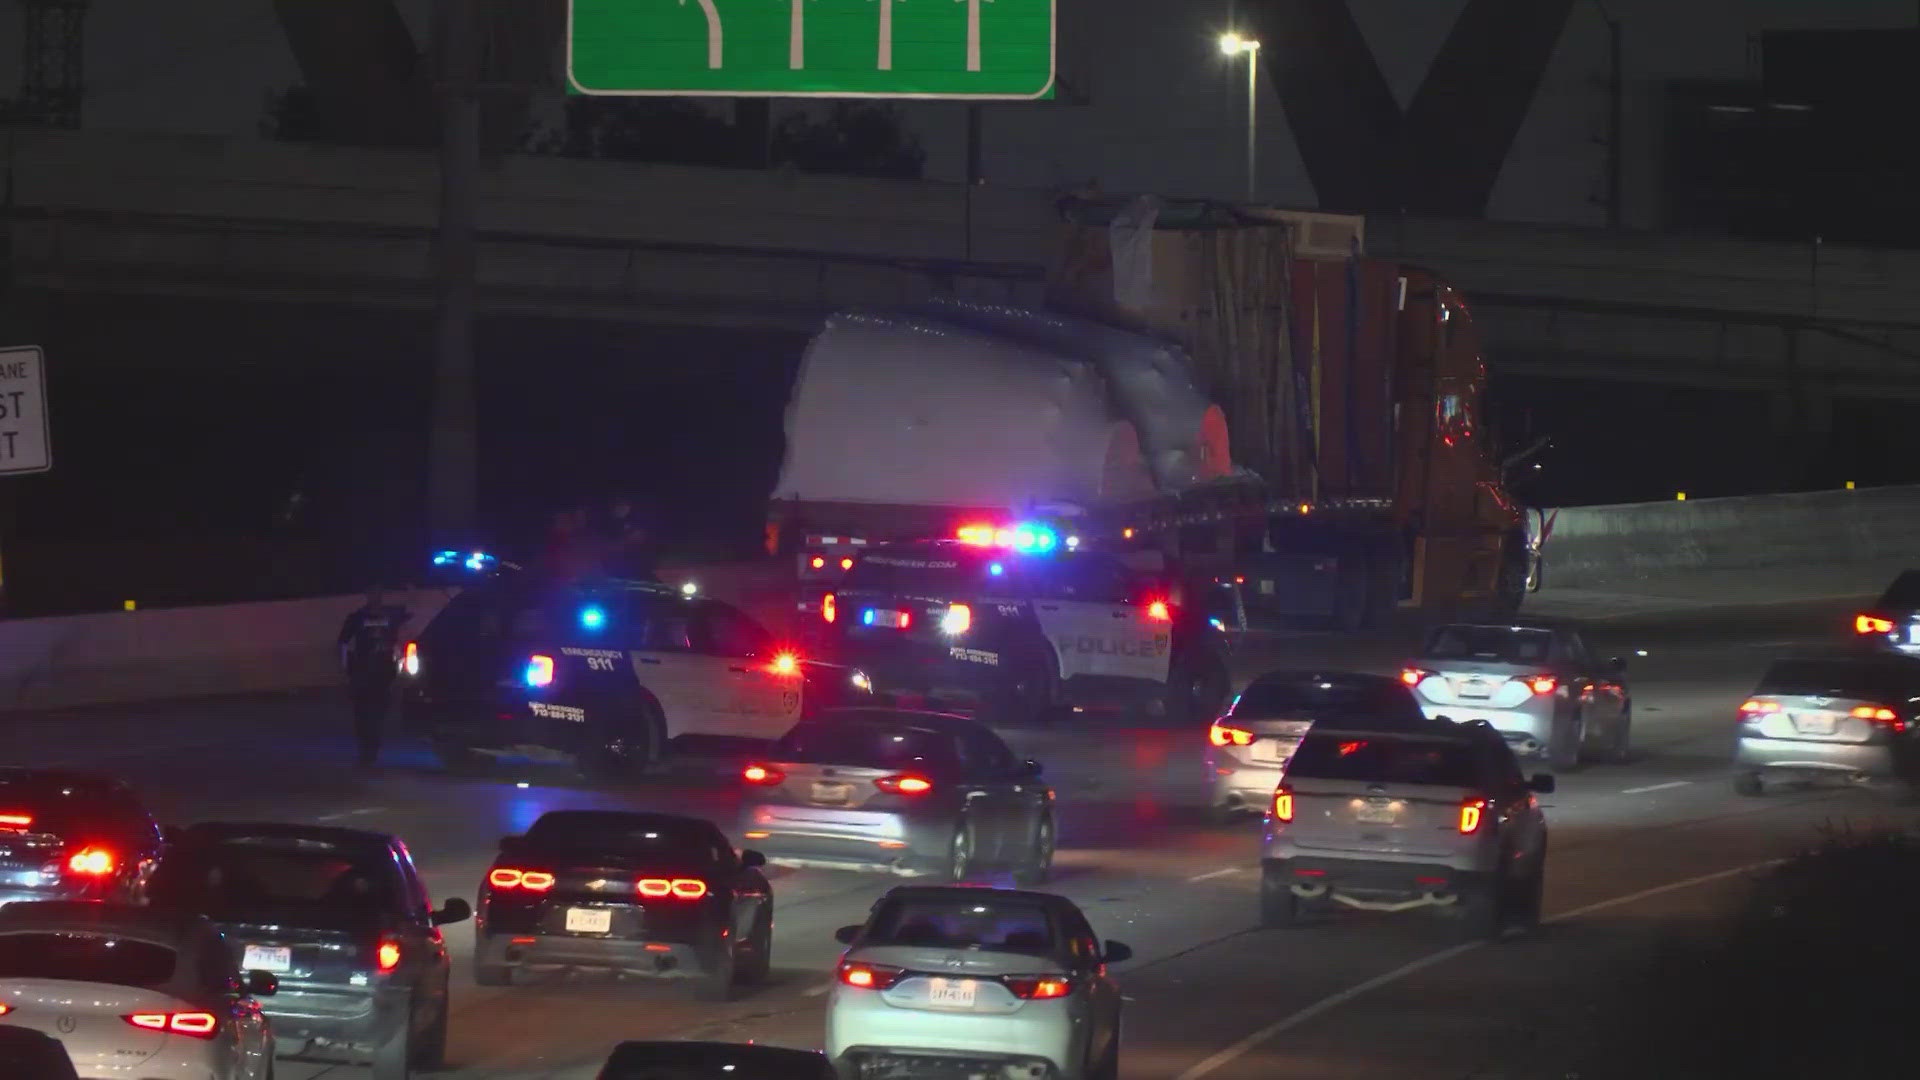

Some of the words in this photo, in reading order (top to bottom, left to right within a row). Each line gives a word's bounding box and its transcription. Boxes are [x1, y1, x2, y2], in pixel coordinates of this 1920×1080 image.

[561, 647, 623, 659] EMERGENCY
[1059, 636, 1154, 657] POLICE
[587, 657, 615, 671] 911
